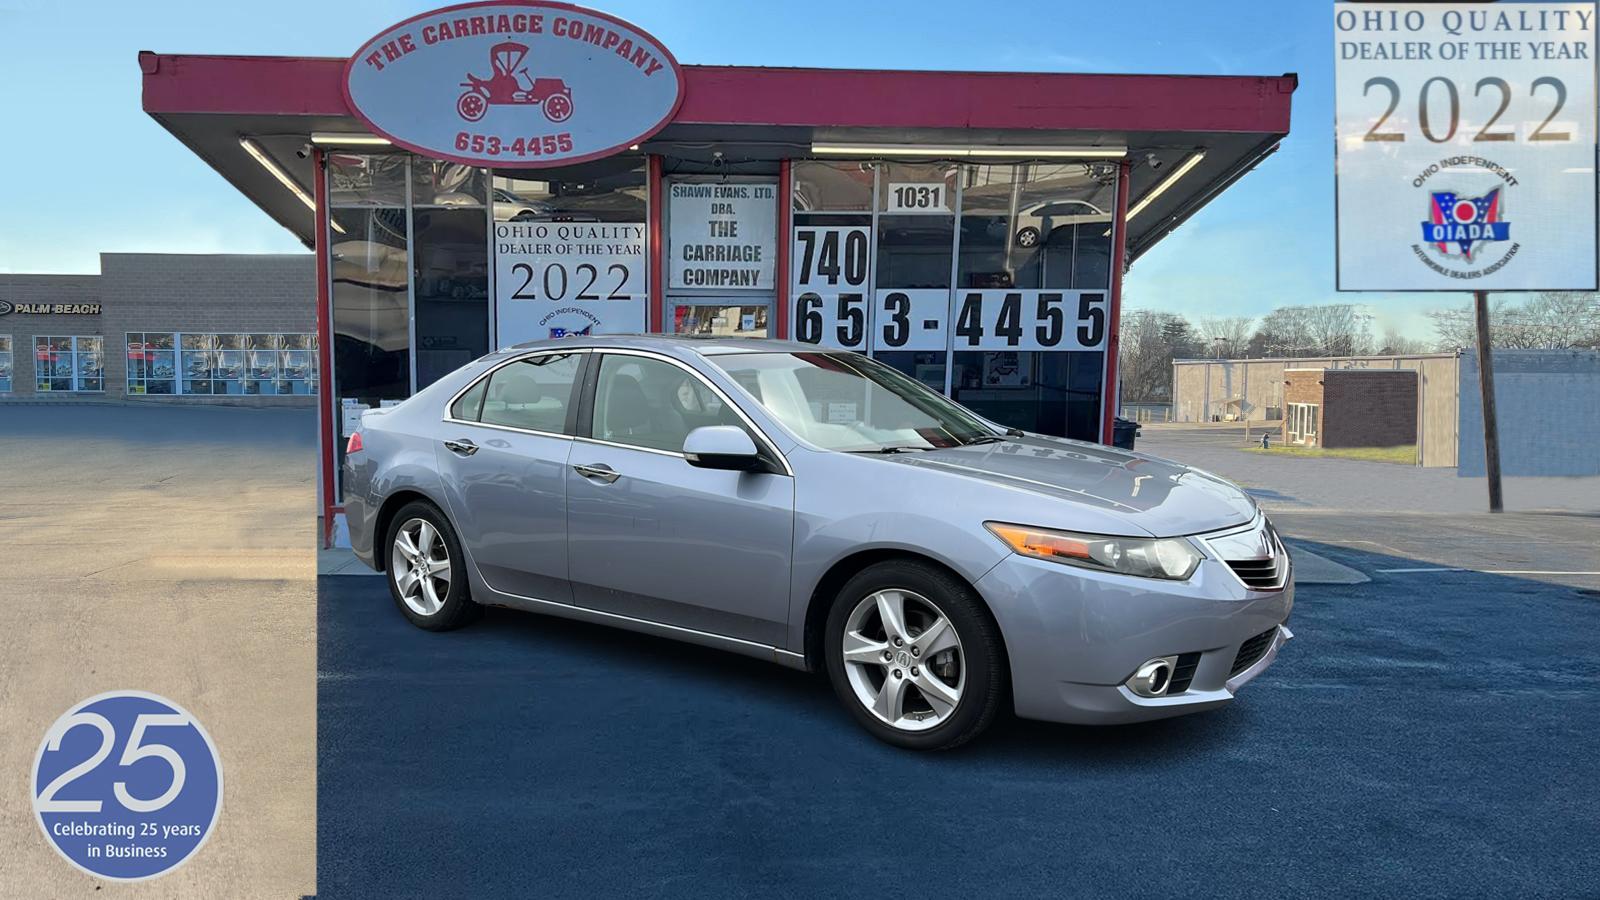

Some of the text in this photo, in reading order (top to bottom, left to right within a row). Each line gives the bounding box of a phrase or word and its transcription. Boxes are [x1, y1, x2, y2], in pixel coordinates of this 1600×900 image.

[1336, 10, 1592, 35] OHIO QUALITY
[366, 14, 663, 77] THE CARRIAGE COMPANY
[1340, 42, 1589, 60] DEALER OF THE YEAR
[1363, 76, 1570, 143] 2022
[455, 132, 573, 156] 653-4455
[1413, 156, 1519, 188] OHIO INDEPENDENT
[672, 186, 712, 199] SHAWN
[754, 187, 775, 199] LTD.
[894, 187, 940, 207] 1031
[711, 203, 736, 215] DBA.
[497, 226, 644, 241] OHIO QUALITY
[709, 220, 738, 238] THE
[1432, 224, 1495, 240] OIADA
[500, 244, 641, 255] DEALER OF THE YEAR
[683, 244, 762, 262] CARRIAGE
[797, 230, 867, 286] 740
[1411, 242, 1520, 279] AUTOMOBILE DEALERS ASSOCIATION
[511, 263, 631, 300] 2022
[683, 268, 760, 286] COMPANY
[15, 304, 100, 314] PALM BEACH
[539, 307, 601, 326] OHIO INDEPENDENT
